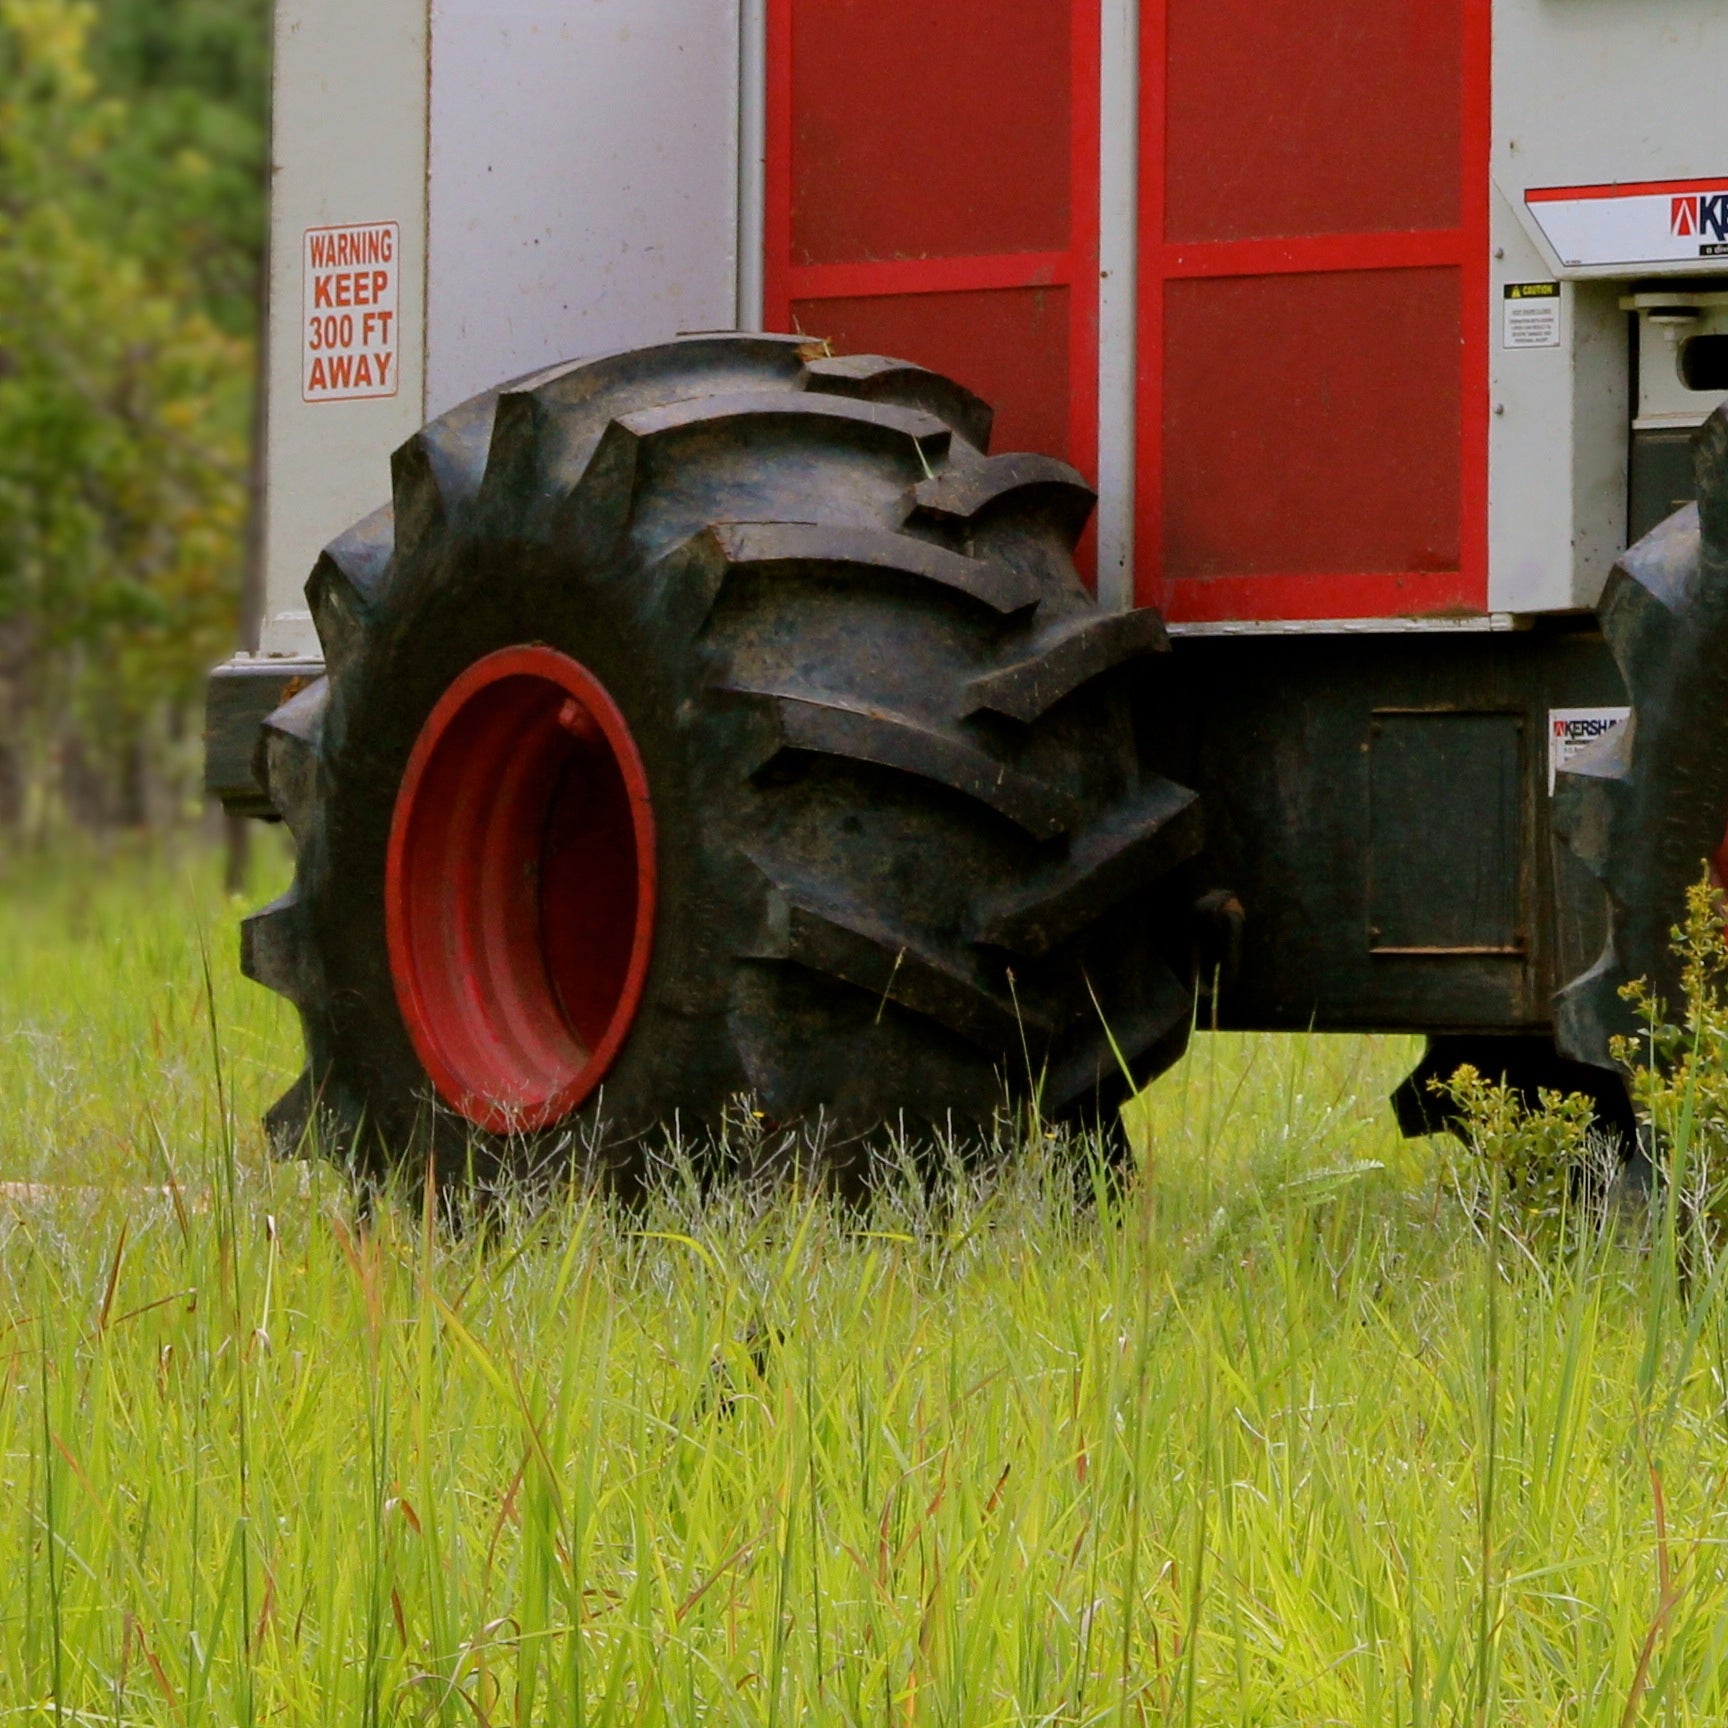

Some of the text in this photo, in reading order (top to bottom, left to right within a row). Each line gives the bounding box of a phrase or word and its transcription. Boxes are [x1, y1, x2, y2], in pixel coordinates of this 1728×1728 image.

[309, 229, 392, 268] WARNING
[314, 270, 388, 309] KEEP
[1522, 284, 1552, 296] CAUTION
[309, 311, 393, 350] 300 FT
[308, 352, 392, 391] AWAY
